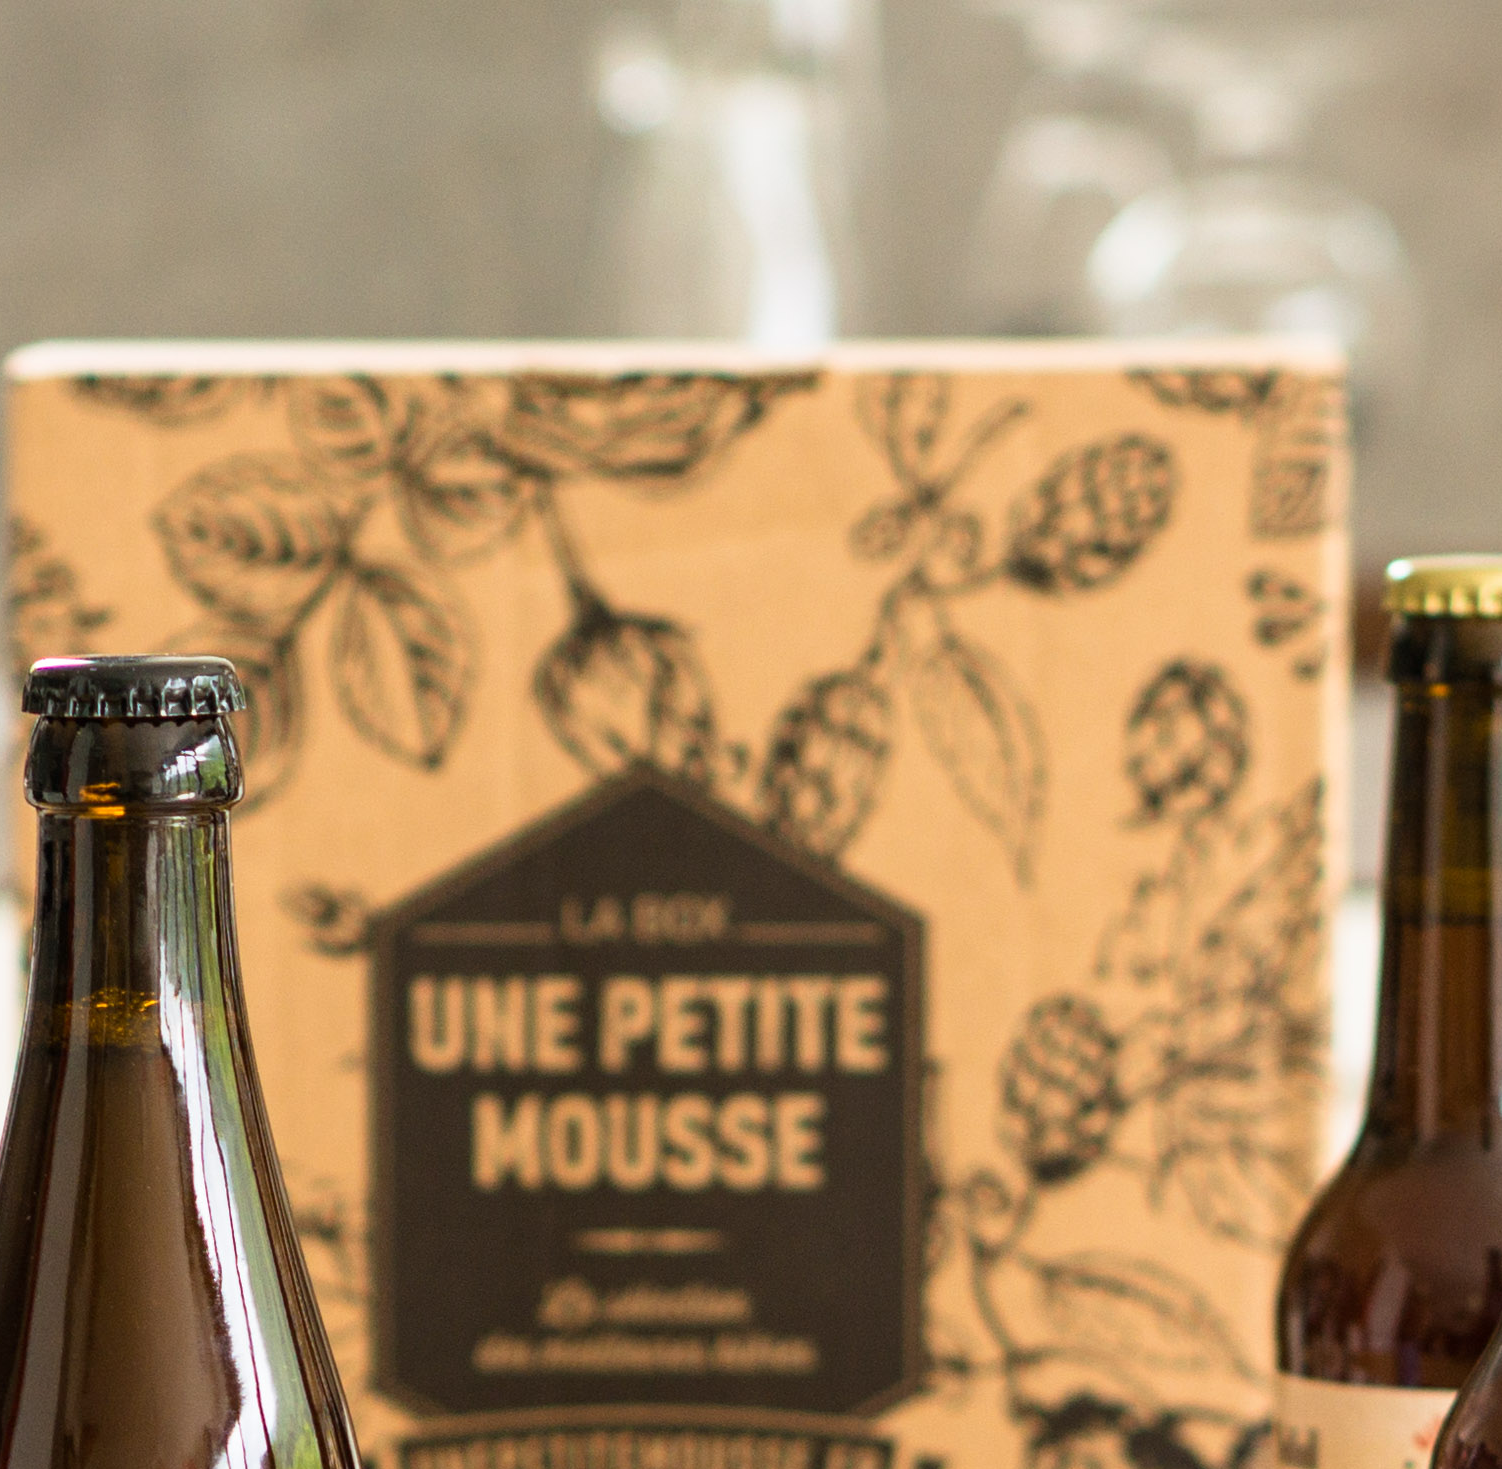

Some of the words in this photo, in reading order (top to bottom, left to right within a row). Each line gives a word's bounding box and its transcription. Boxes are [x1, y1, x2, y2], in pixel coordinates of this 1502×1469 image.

[409, 975, 582, 1074] UNE
[601, 975, 889, 1074] PETITE
[472, 1094, 825, 1189] MOUSSE
